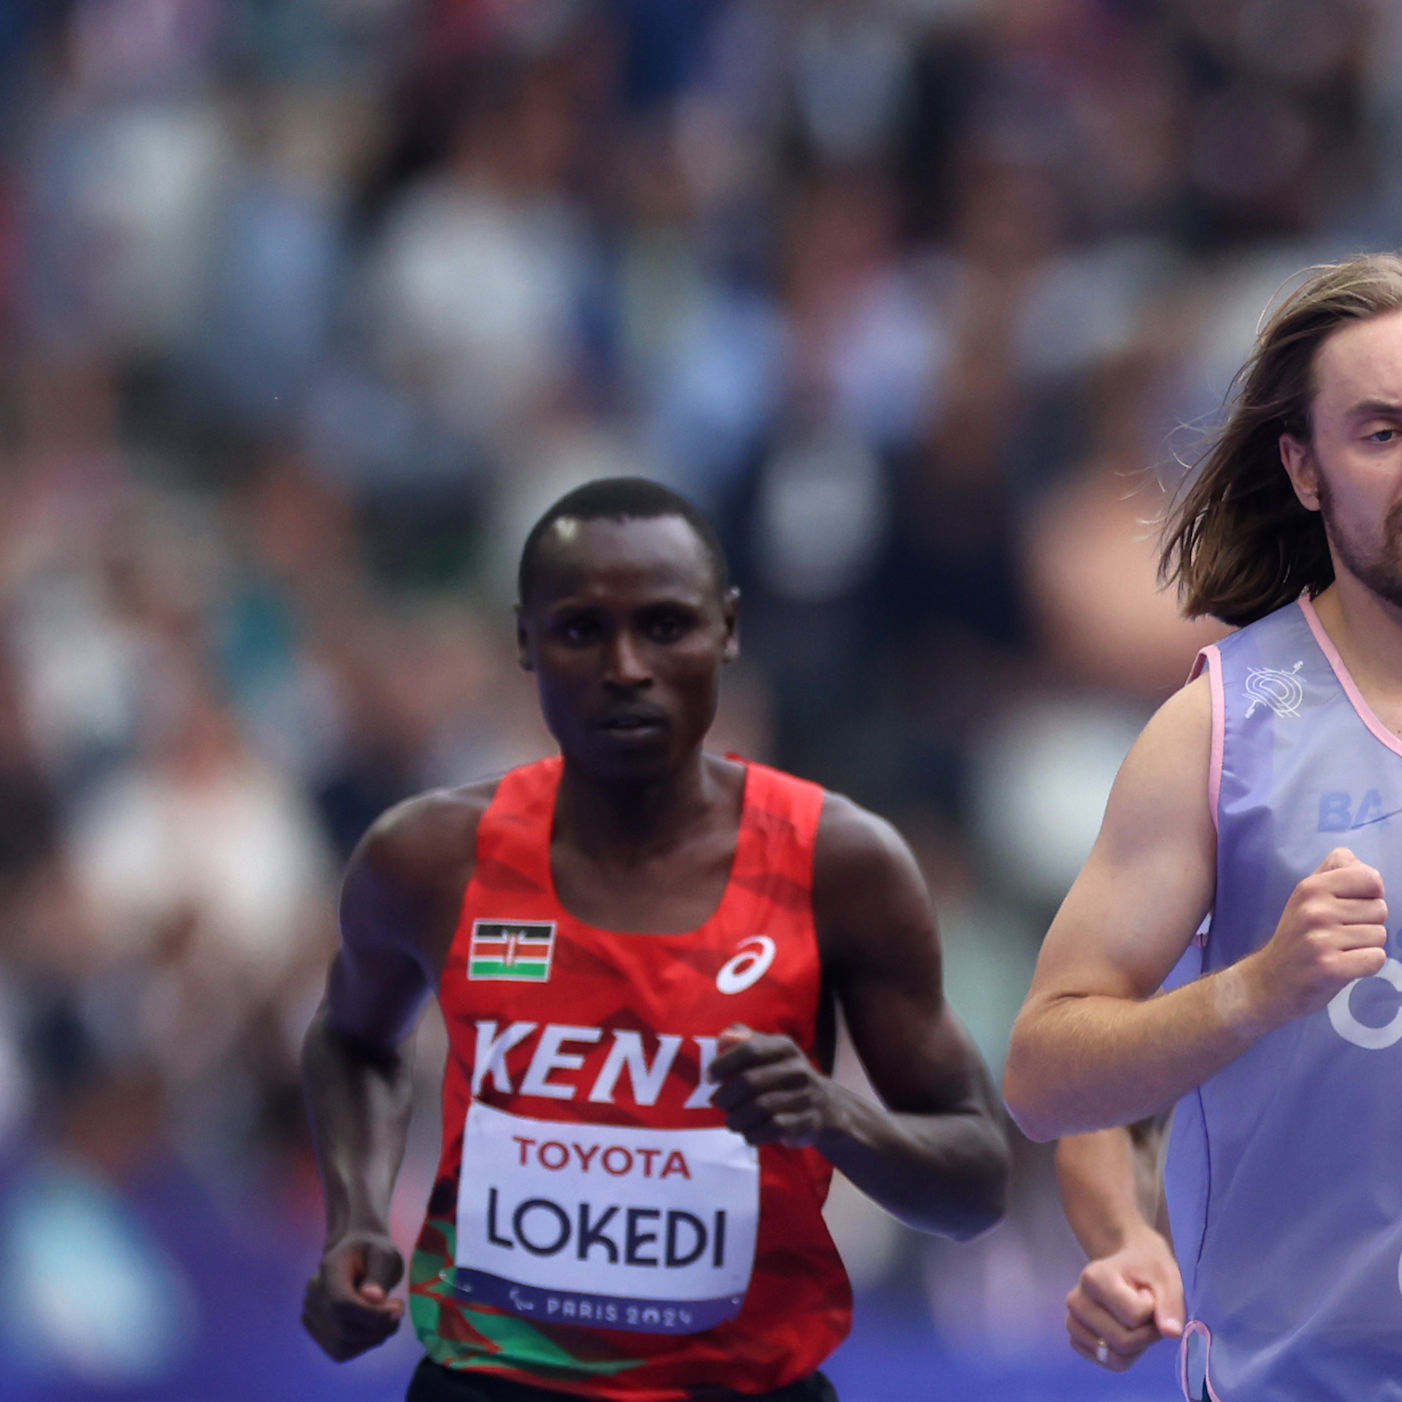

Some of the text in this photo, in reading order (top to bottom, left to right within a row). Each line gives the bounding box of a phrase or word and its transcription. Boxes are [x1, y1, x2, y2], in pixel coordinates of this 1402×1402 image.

[471, 1020, 720, 1109] KENY
[513, 1135, 692, 1180] TOYOTA
[486, 1187, 727, 1269] LOKEDI
[546, 1297, 693, 1327] PARIS 2024
